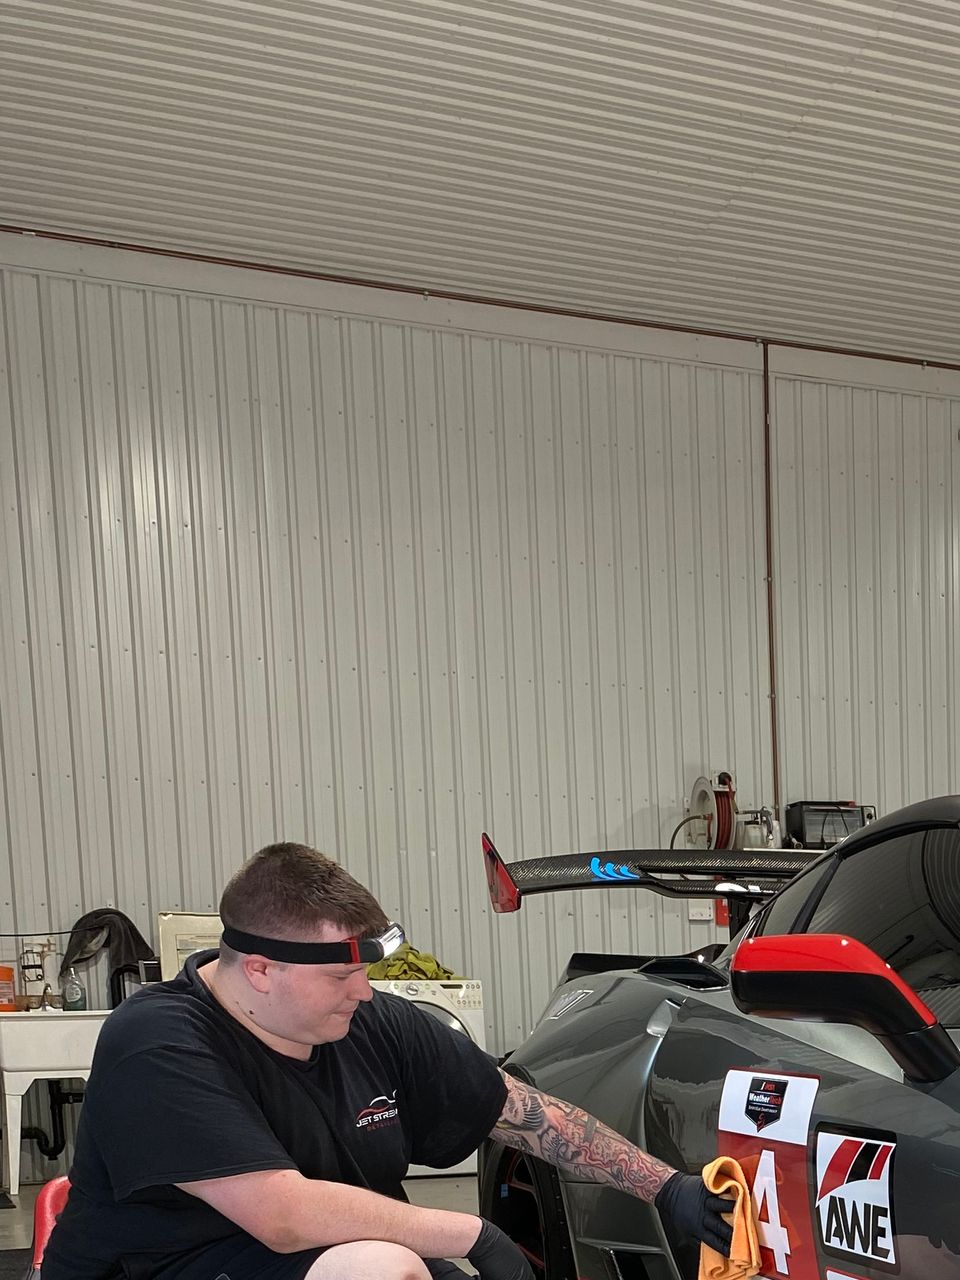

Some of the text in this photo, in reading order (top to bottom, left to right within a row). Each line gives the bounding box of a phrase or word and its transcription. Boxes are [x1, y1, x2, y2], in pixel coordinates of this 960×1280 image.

[356, 1116, 372, 1128] JET
[752, 1149, 791, 1276] 4
[825, 1194, 891, 1260] AWE
